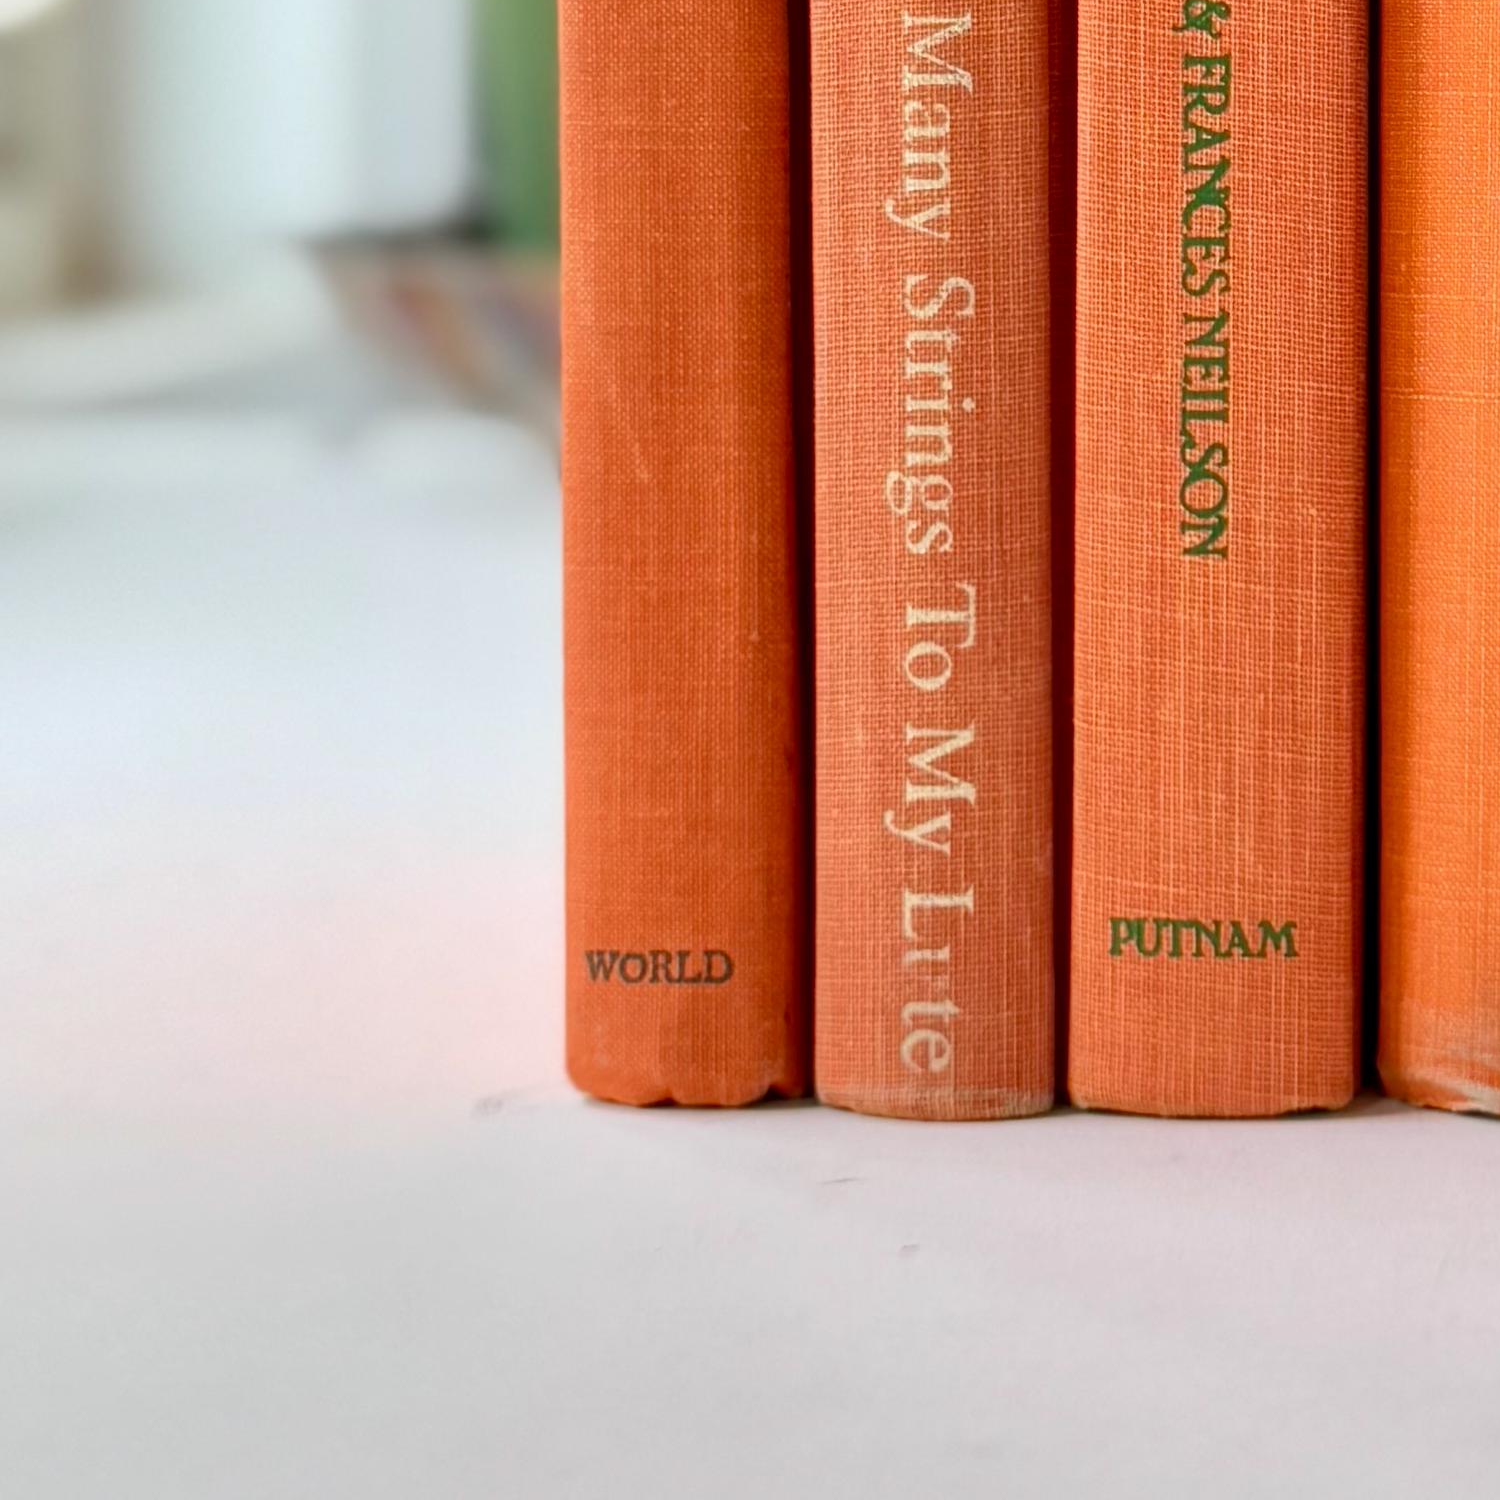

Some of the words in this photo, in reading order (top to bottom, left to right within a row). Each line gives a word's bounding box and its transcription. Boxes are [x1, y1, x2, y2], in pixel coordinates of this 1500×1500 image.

[885, 11, 973, 242] Many
[1180, 54, 1232, 297] FRANCES
[886, 275, 975, 556] Strings
[1179, 311, 1231, 560] NEILSON
[904, 580, 976, 692] To
[883, 720, 977, 857] My
[584, 950, 733, 986] WORLD
[1108, 916, 1299, 959] PUTNAM
